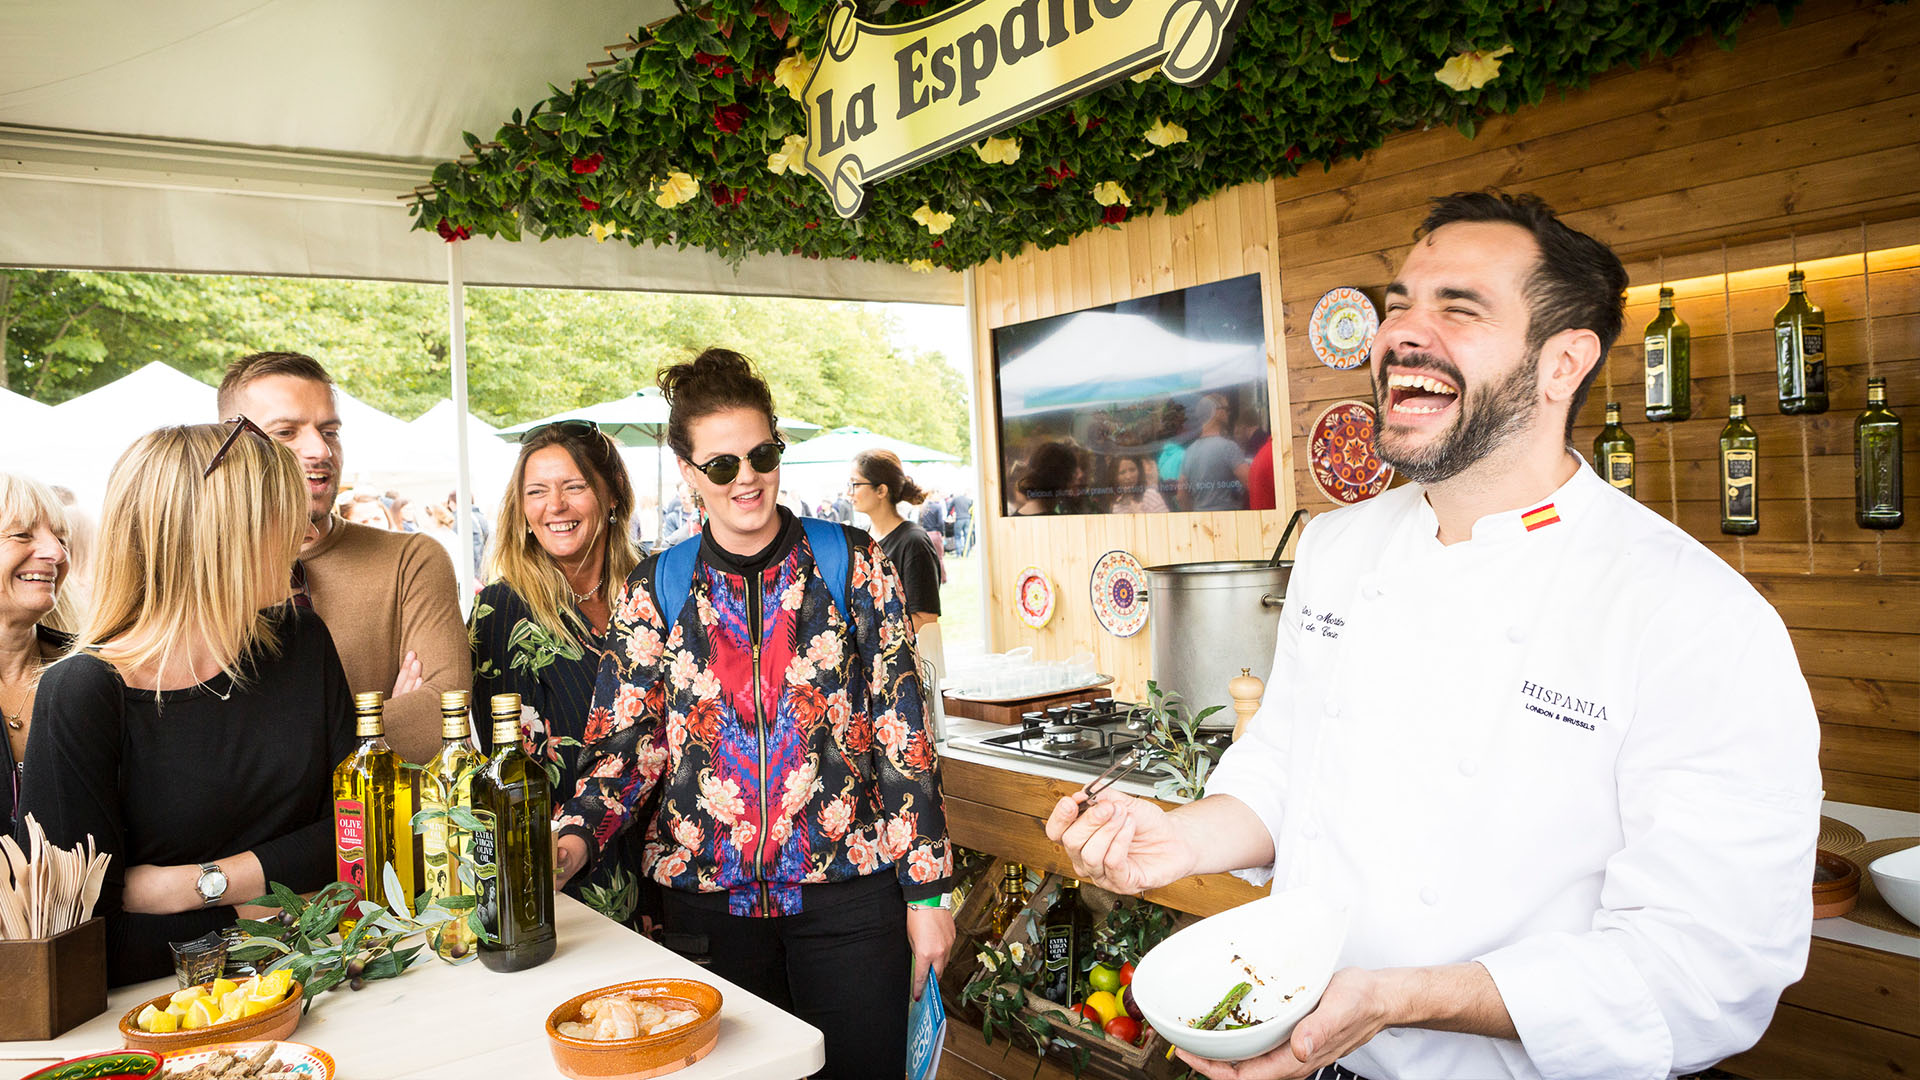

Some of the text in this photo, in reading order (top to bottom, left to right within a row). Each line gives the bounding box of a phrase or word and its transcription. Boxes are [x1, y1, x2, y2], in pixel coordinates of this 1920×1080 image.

[816, 83, 877, 157] La
[1521, 680, 1608, 721] HISPANIA
[1525, 703, 1554, 718] LONDON
[1562, 716, 1596, 731] BRUSSELS
[339, 818, 362, 830] OLIVE
[344, 828, 358, 837] OIL
[475, 830, 494, 840] EXTRA
[475, 838, 494, 848] VIRGIN
[476, 846, 494, 856] OLIVE
[480, 854, 490, 863] OIL
